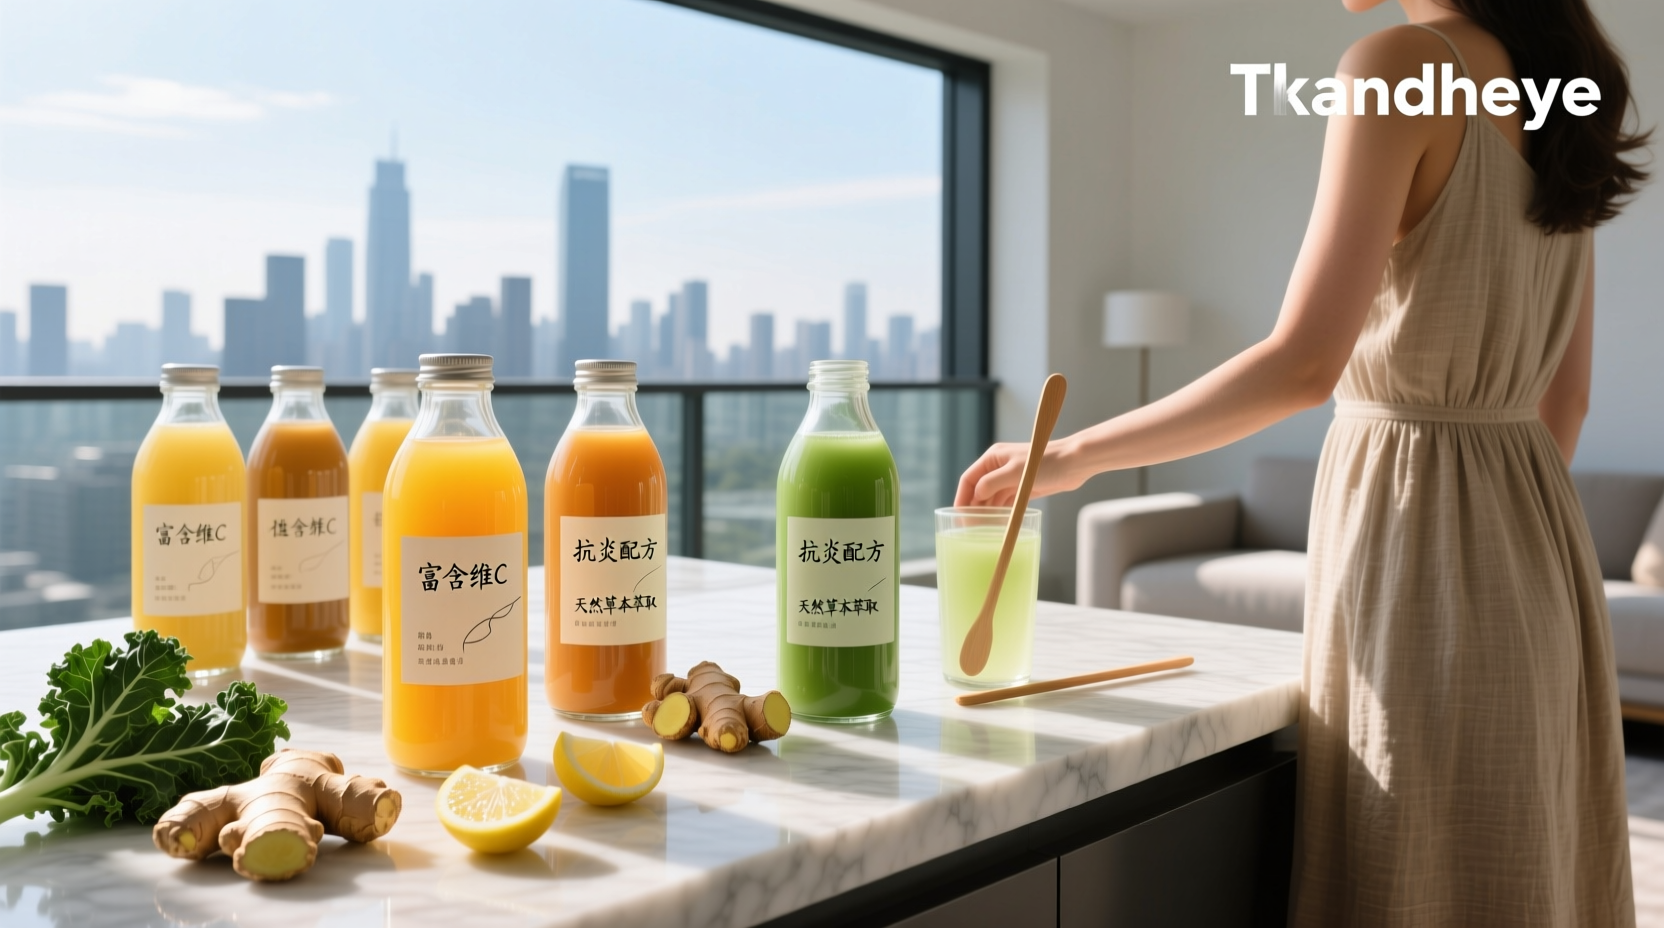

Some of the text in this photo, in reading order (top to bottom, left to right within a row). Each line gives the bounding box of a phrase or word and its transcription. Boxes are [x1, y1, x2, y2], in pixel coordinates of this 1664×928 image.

[573, 537, 657, 562] 抗炎配方
[799, 538, 884, 564] 抗炎配方
[419, 562, 507, 591] 富含维C
